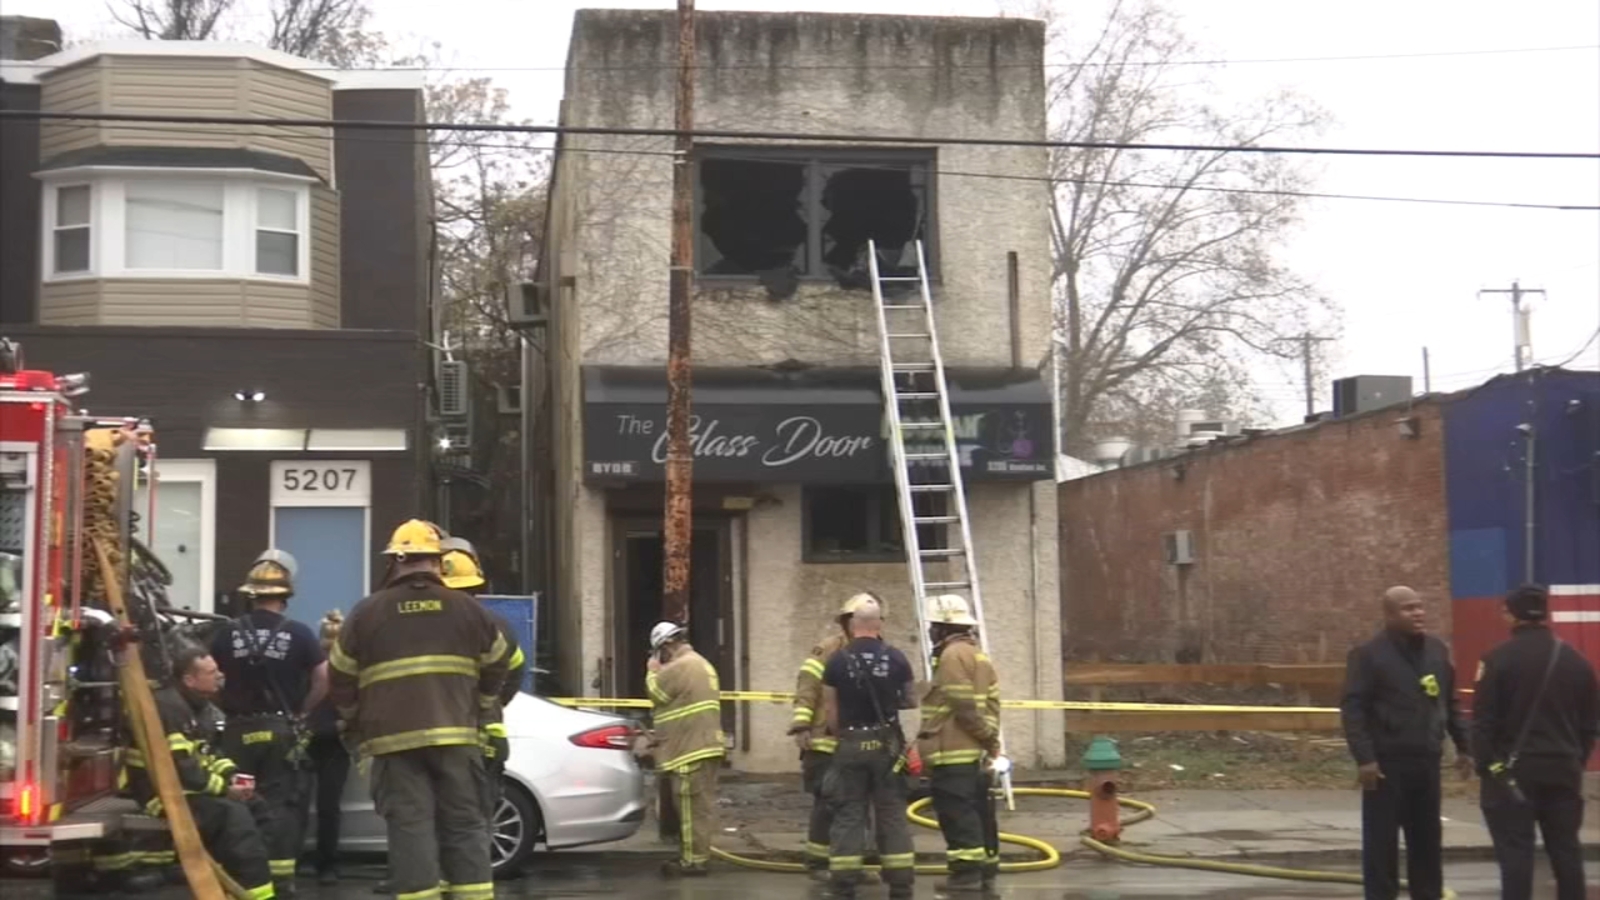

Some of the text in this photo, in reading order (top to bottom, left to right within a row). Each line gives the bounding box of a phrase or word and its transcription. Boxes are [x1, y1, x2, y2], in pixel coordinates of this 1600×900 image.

[616, 414, 654, 435] The
[761, 415, 875, 467] Door
[283, 468, 357, 491] 5207
[396, 599, 442, 614] LEEMON
